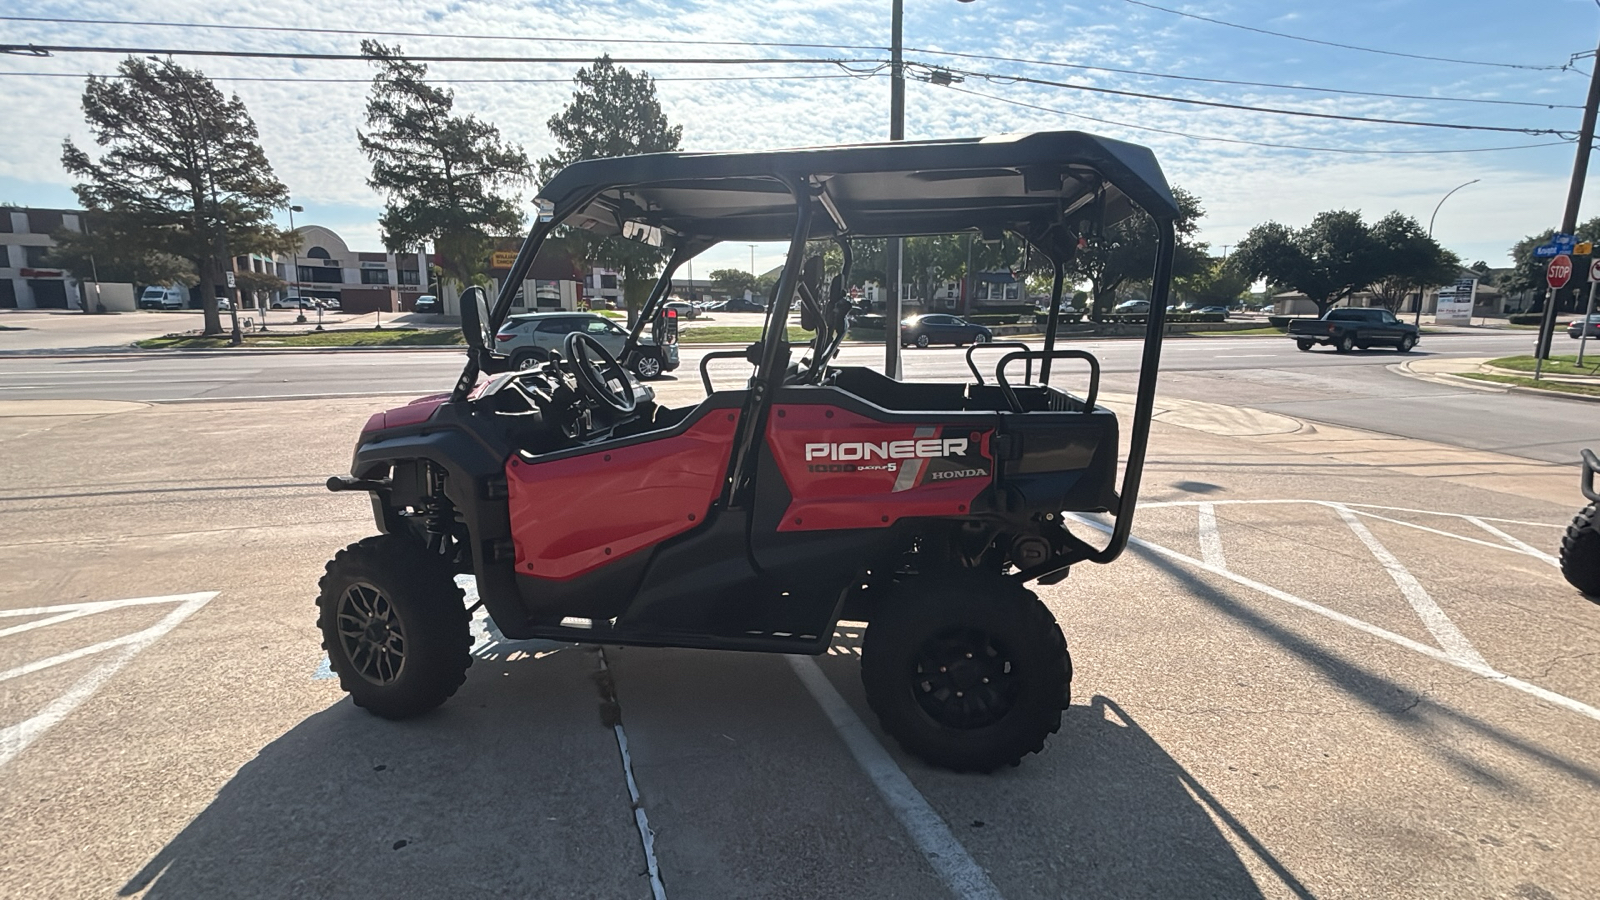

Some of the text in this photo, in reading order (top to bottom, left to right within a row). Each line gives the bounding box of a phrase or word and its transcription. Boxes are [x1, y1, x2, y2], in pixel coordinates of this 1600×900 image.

[1549, 265, 1570, 278] STOP
[805, 438, 968, 461] PIONEER
[808, 463, 856, 473] 1000
[932, 467, 988, 480] HONDA
